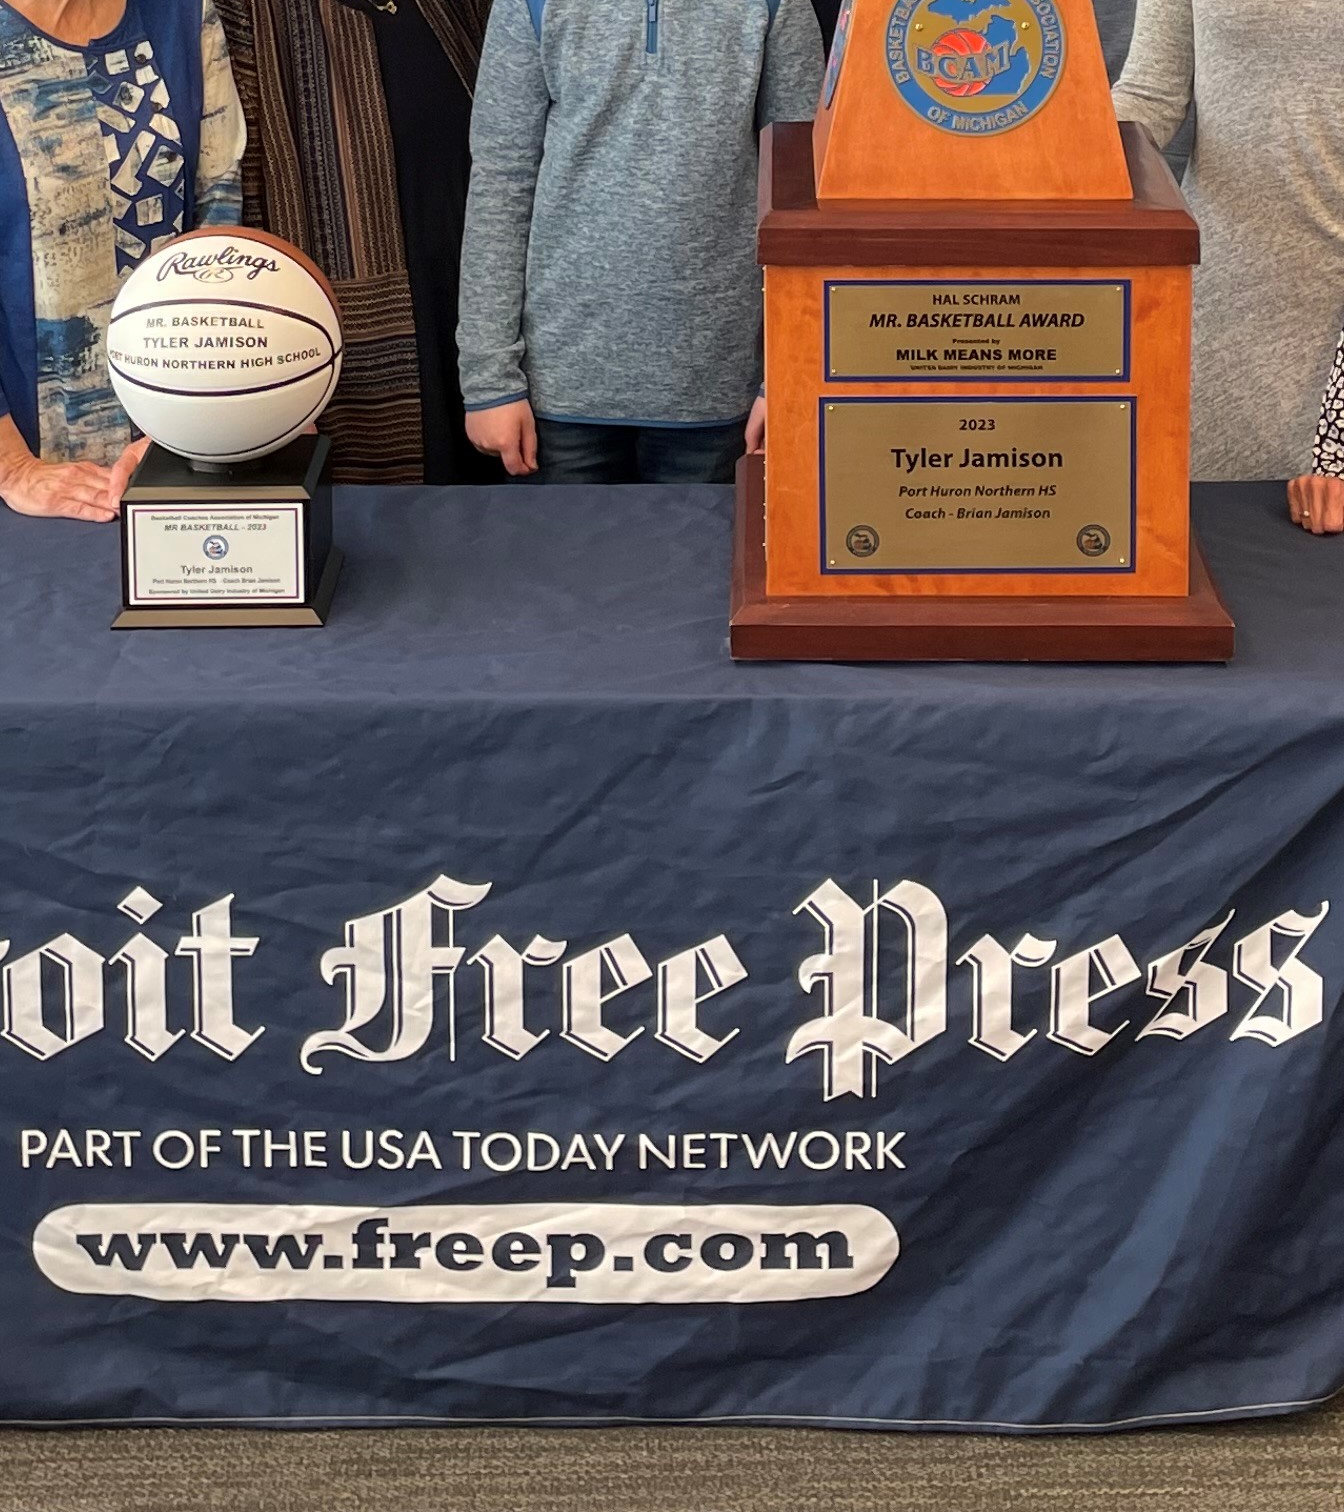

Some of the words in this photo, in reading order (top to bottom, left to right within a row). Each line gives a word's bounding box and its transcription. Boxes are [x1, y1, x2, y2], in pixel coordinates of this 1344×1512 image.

[915, 41, 1011, 83] BCAM
[927, 105, 951, 124] OF
[951, 100, 1030, 132] MICHIGAN
[156, 246, 281, 281] Rawlings
[932, 294, 960, 306] HAL
[963, 294, 1021, 306] SCHRAM
[146, 318, 167, 329] MR.
[171, 316, 265, 329] BASKETBALL
[869, 313, 902, 329] MR.
[906, 313, 1016, 328] BASKETBALL
[1019, 313, 1085, 328] AWARD
[143, 337, 190, 349] TYLER
[194, 336, 268, 348] JAMISON
[124, 353, 159, 368] HURON
[162, 359, 236, 370] NORTHERN
[240, 353, 273, 369] HIGH
[276, 347, 322, 365] SCHOOL
[896, 349, 939, 361] MILK
[943, 349, 1003, 361] MEANS
[1008, 349, 1057, 361] MORE
[959, 419, 996, 431] 2023
[890, 448, 954, 473] Tyler
[959, 448, 1063, 468] Jamison
[899, 485, 928, 497] Port
[930, 485, 972, 497] Huron
[975, 485, 1035, 497] Northern
[1038, 485, 1057, 496] HS
[905, 507, 946, 519] Coach
[956, 507, 993, 519] Brian
[995, 507, 1051, 519] Jamison
[180, 565, 206, 576] Tyler
[208, 565, 253, 574] Jamison
[300, 874, 748, 1074] Free
[788, 878, 1329, 1101] Press
[22, 1129, 141, 1168] PART
[153, 1130, 221, 1168] OF
[232, 1130, 327, 1167] THE
[342, 1130, 442, 1169] USA
[455, 1132, 625, 1171] TODAY
[639, 1131, 905, 1169] NETWORK
[77, 1219, 855, 1289] www.freep.com
